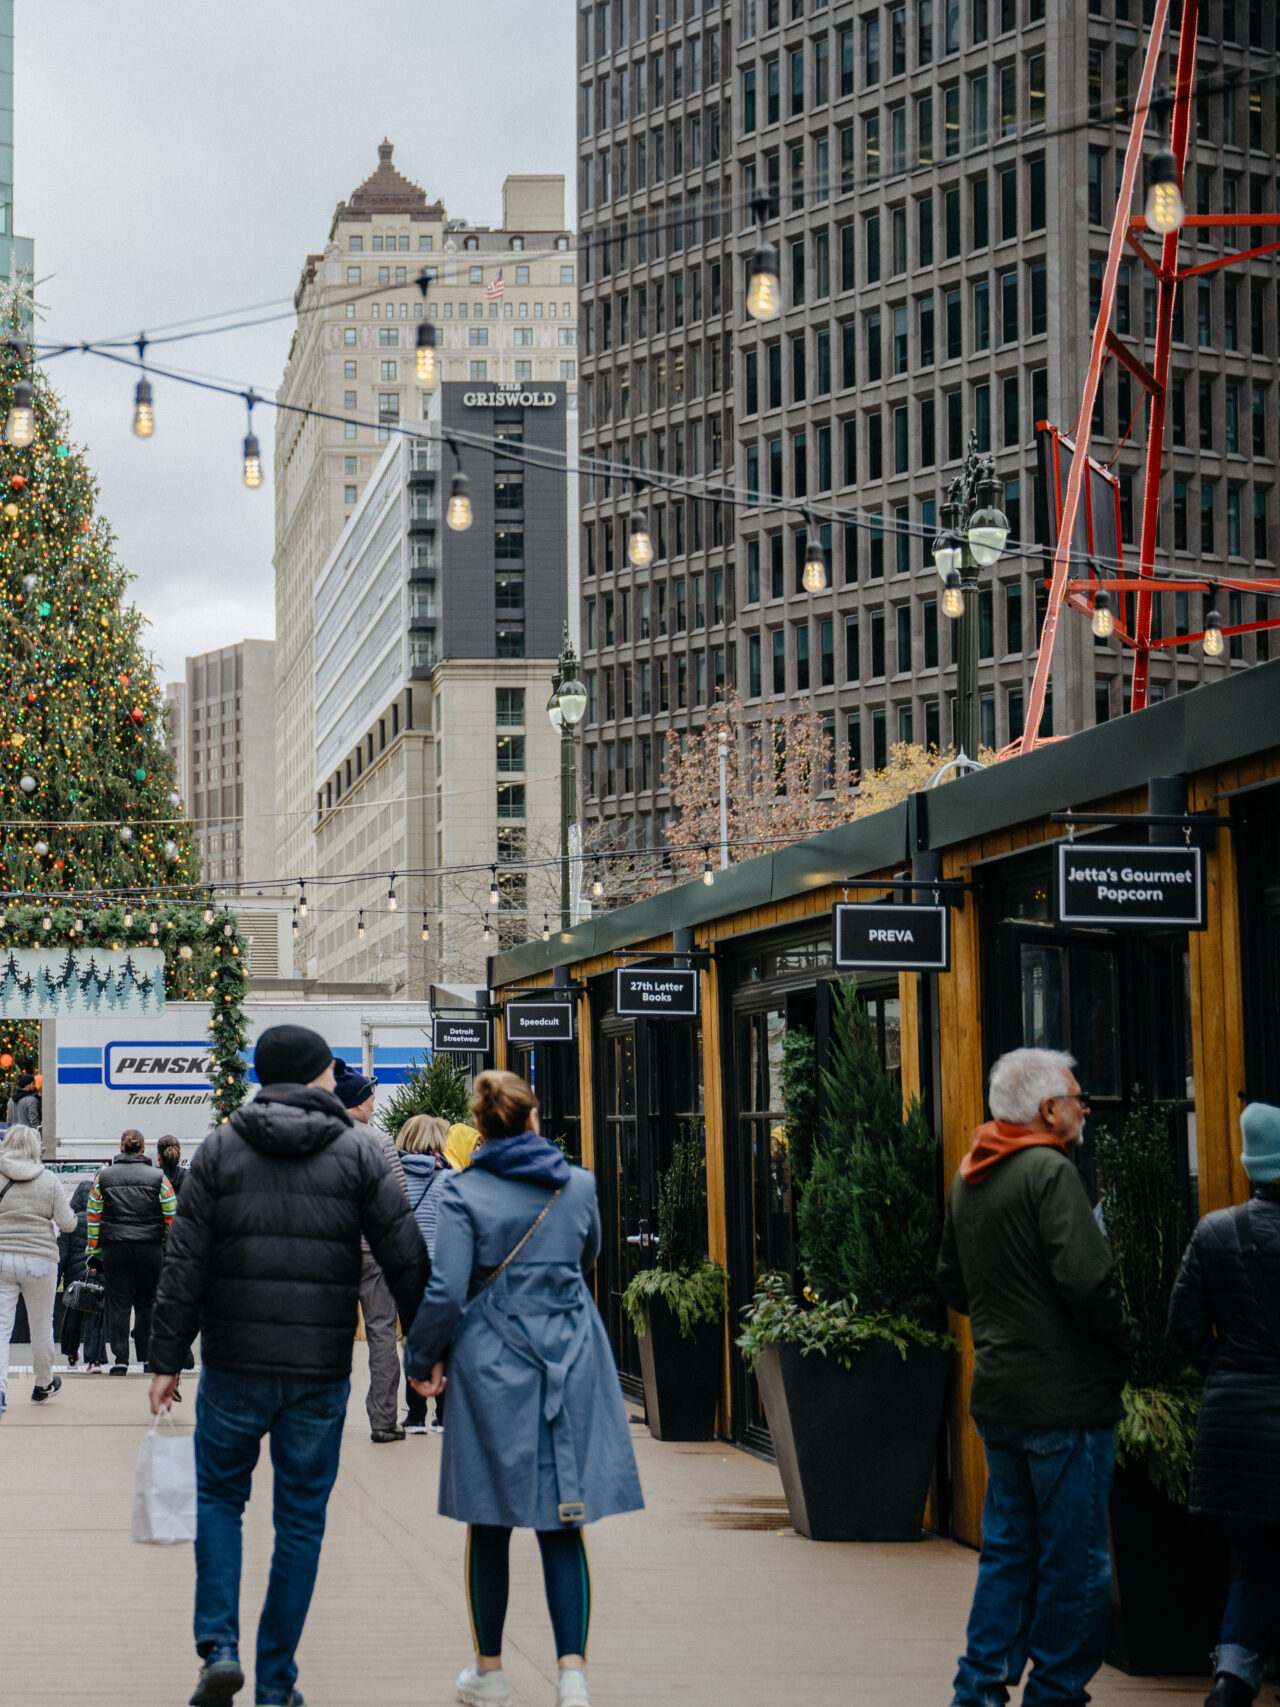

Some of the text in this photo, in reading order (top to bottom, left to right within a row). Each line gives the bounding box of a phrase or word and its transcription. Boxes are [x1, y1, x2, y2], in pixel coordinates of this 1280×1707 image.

[498, 382, 522, 391] THE
[463, 392, 557, 407] GRISWOLD
[1068, 867, 1193, 883] Jetta's Gourmet
[1097, 886, 1164, 903] Popcorn
[868, 929, 915, 943] PREVA
[630, 982, 684, 992] 27th Letter
[642, 992, 672, 1002] Books
[519, 1018, 560, 1027] Speedcult
[449, 1028, 474, 1036] Detroit
[443, 1035, 481, 1043] Streetwear
[127, 1092, 209, 1105] Truck Rental
